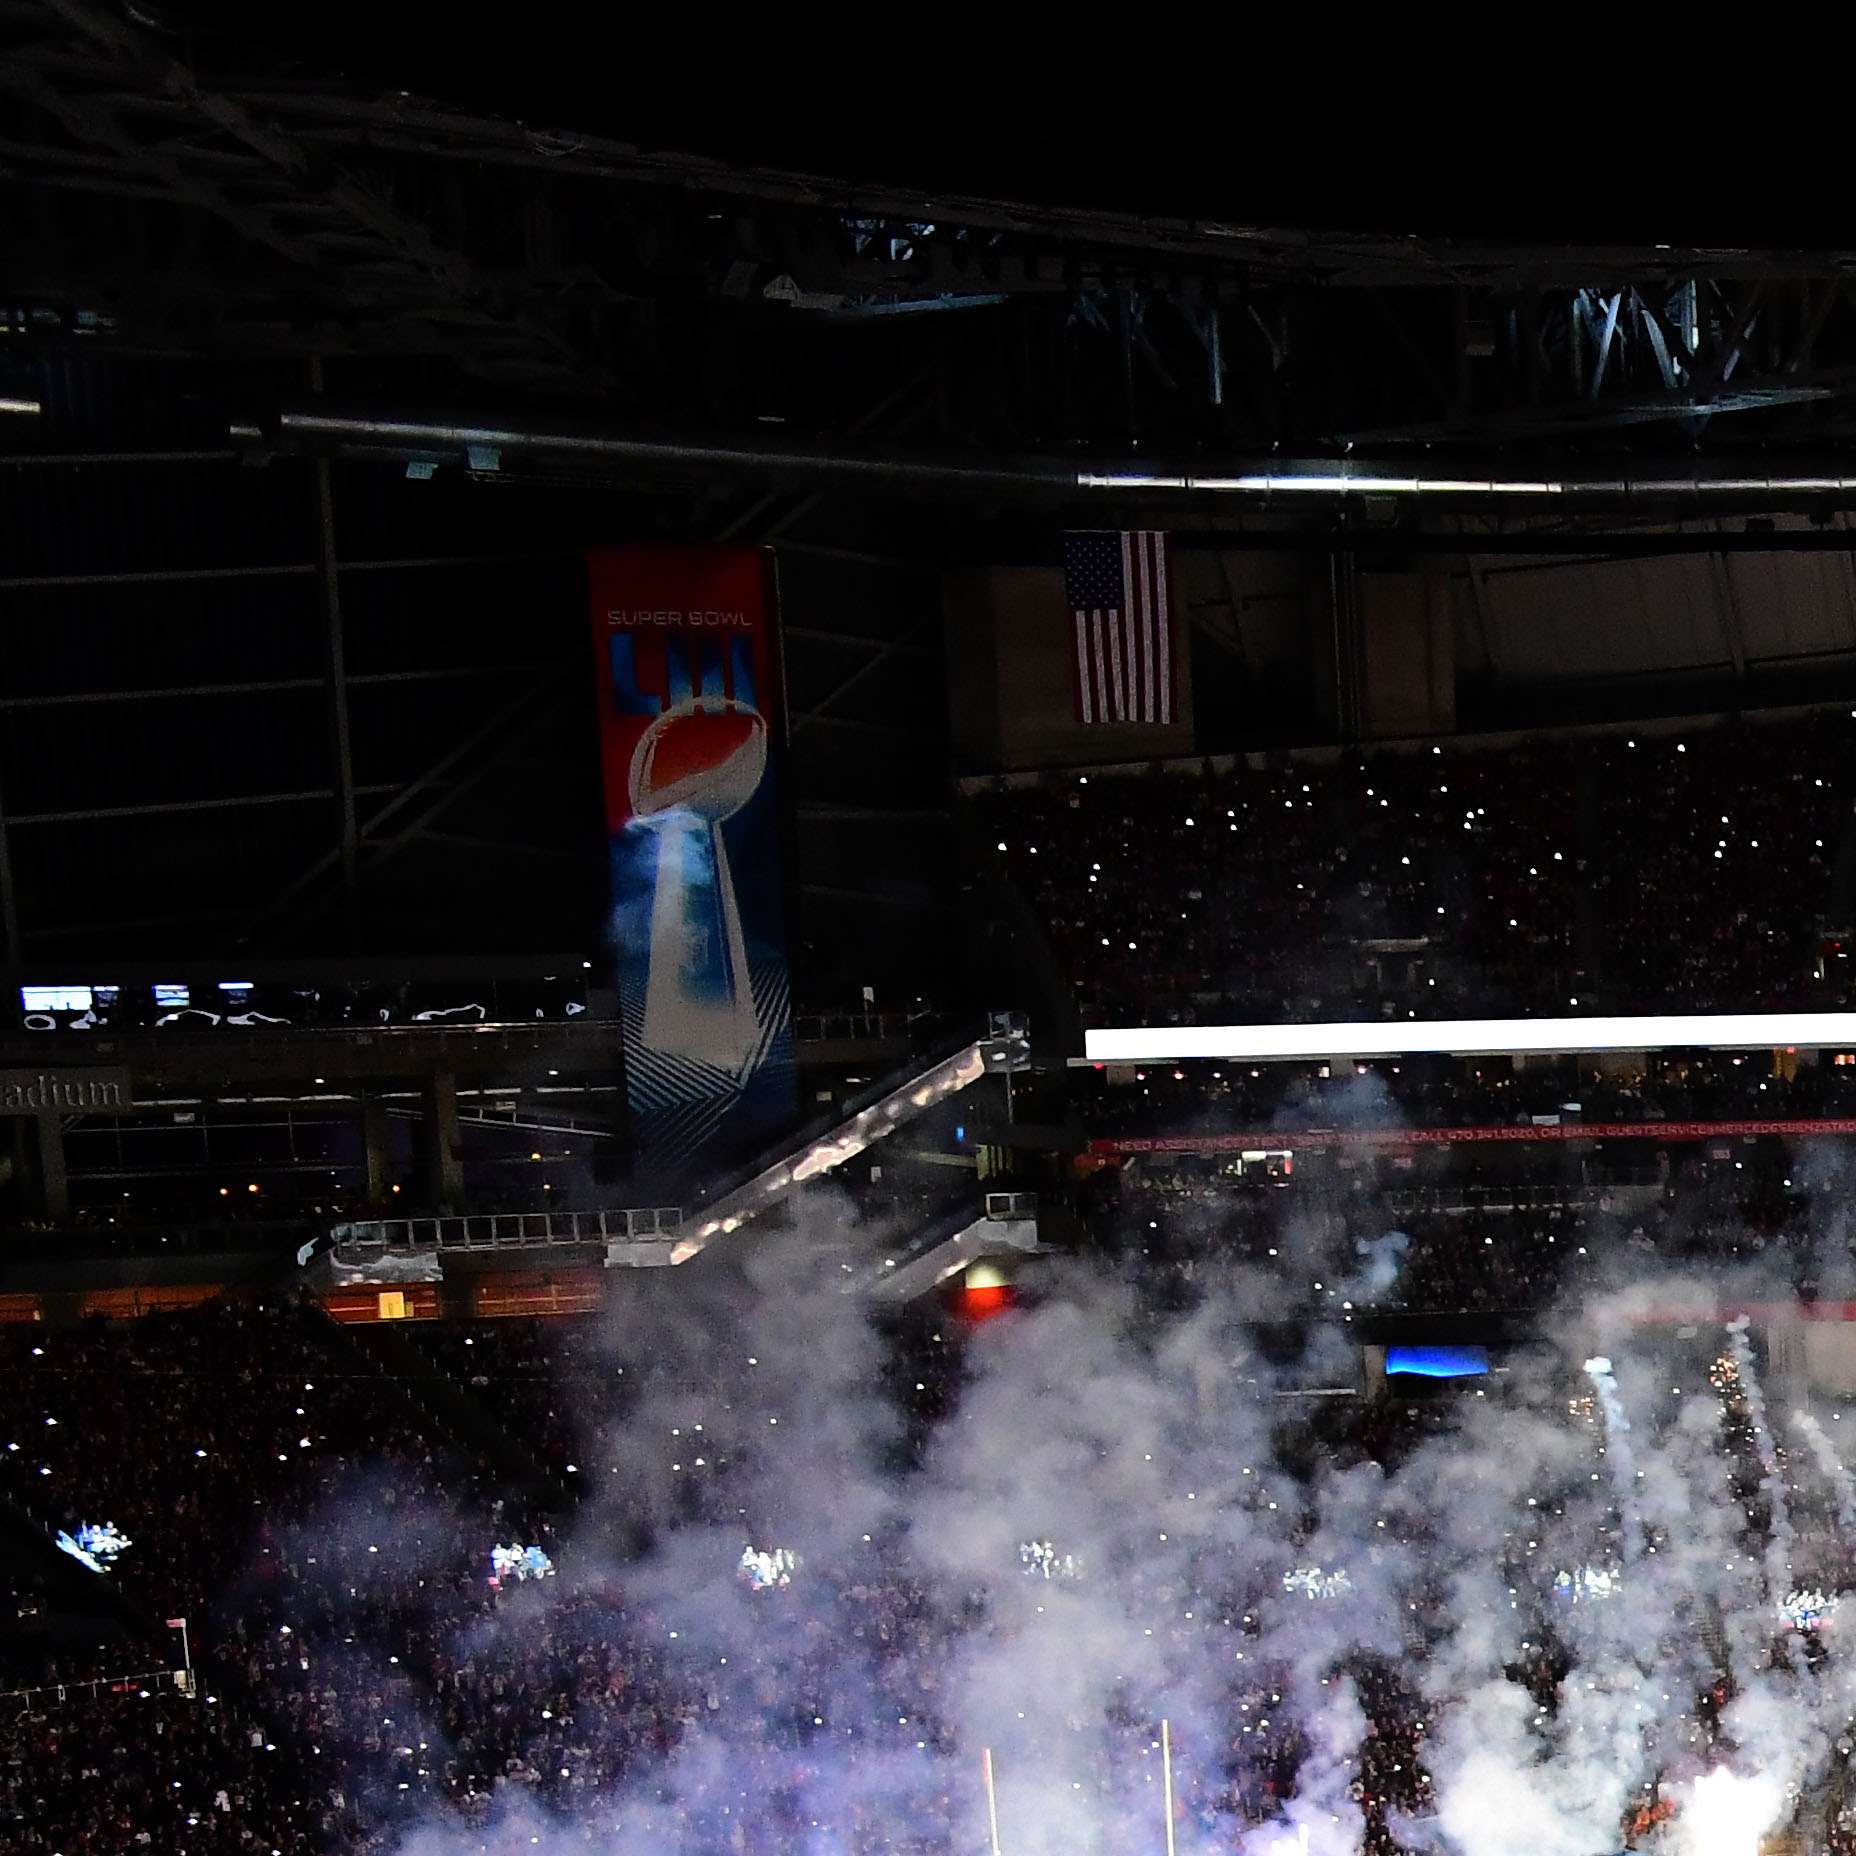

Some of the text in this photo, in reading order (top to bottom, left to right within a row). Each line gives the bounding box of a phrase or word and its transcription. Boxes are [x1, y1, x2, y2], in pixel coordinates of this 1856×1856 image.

[607, 608, 753, 627] SUPER BOWL
[3, 1073, 123, 1107] adium
